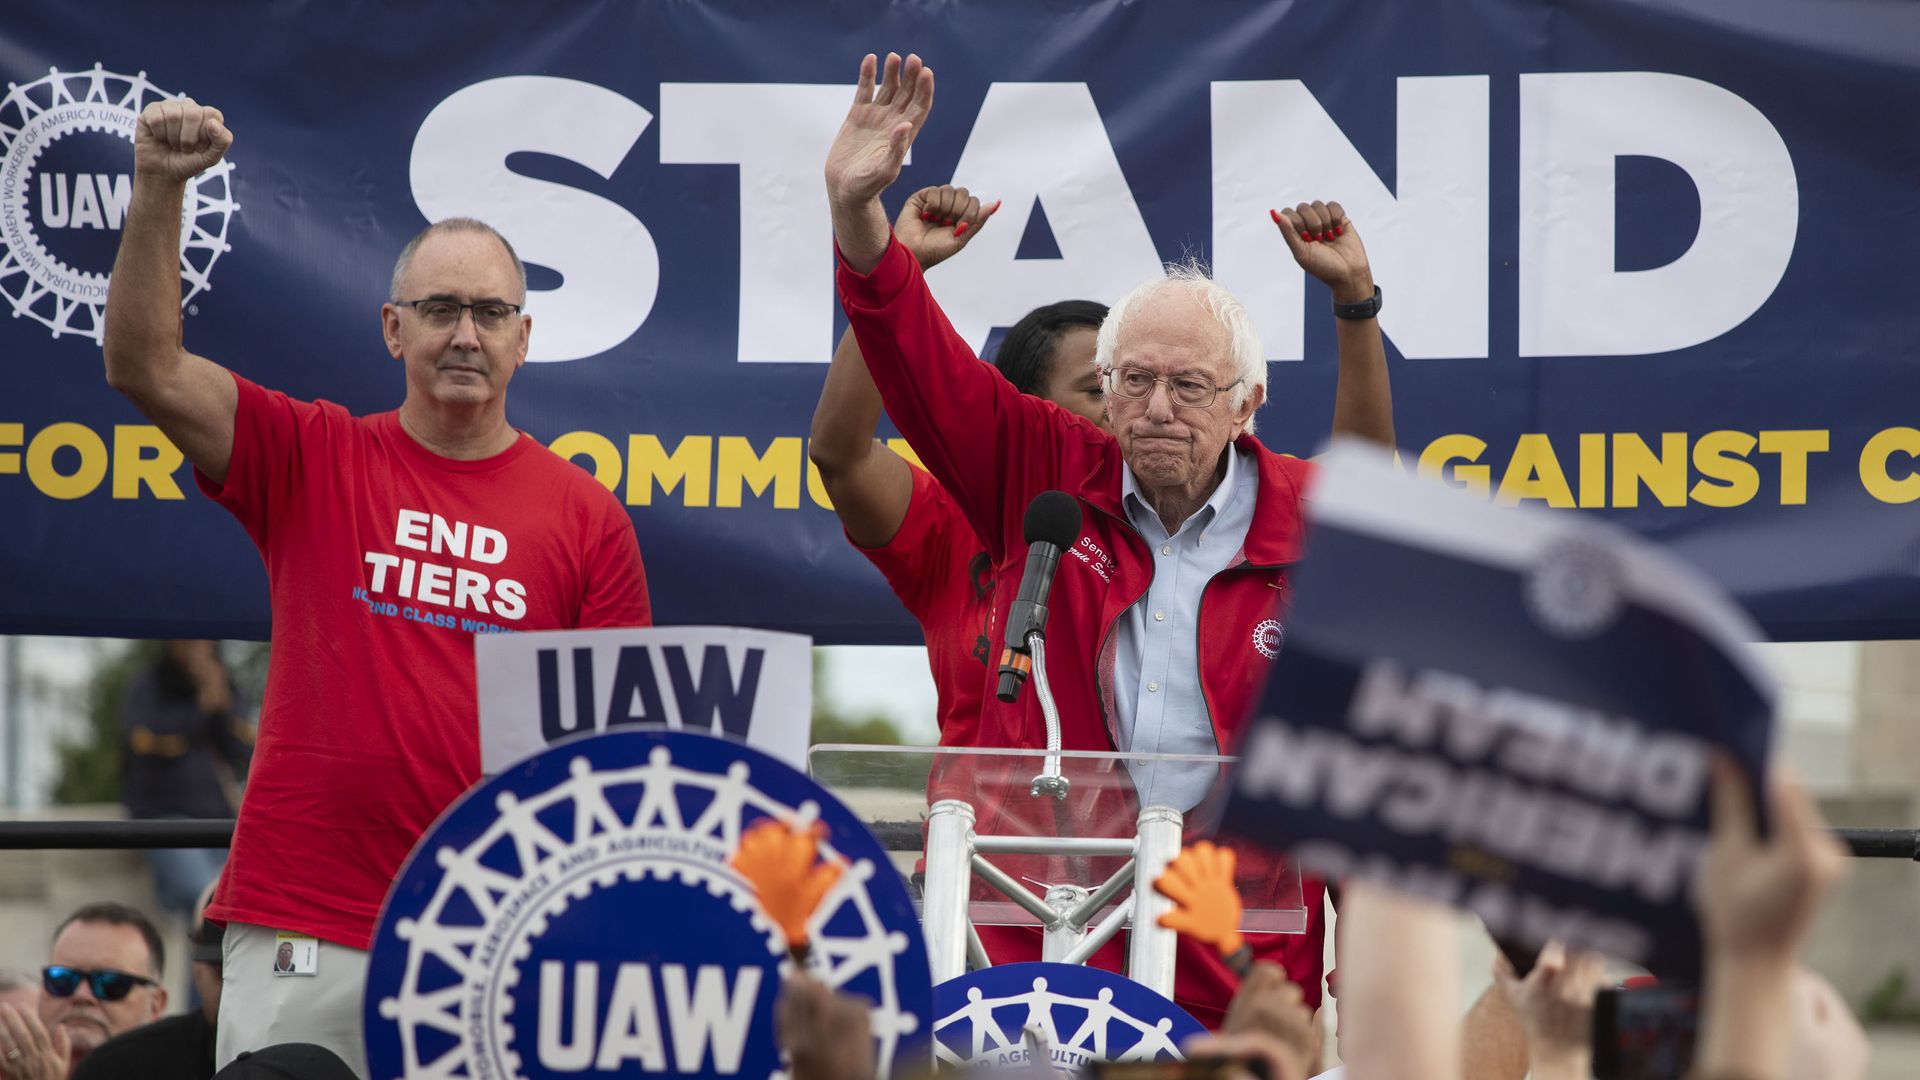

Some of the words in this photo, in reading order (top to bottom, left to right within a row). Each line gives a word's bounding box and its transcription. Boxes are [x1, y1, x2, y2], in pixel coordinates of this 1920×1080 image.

[25, 129, 40, 145] OF
[41, 108, 96, 134] AMERICA
[99, 109, 137, 130] UNITE
[3, 143, 29, 201] WORKERS
[39, 172, 134, 231] UAW
[408, 71, 1799, 364] STAND
[3, 202, 44, 271] IMPLEMENT
[1394, 429, 1830, 509] GAINST
[395, 508, 508, 565] END
[364, 551, 527, 620] TIERS
[402, 606, 457, 630] CLASS
[537, 644, 766, 744] UAW
[558, 847, 600, 873] AND
[607, 835, 728, 866] AGRICULTUR
[536, 959, 764, 1074] UAW
